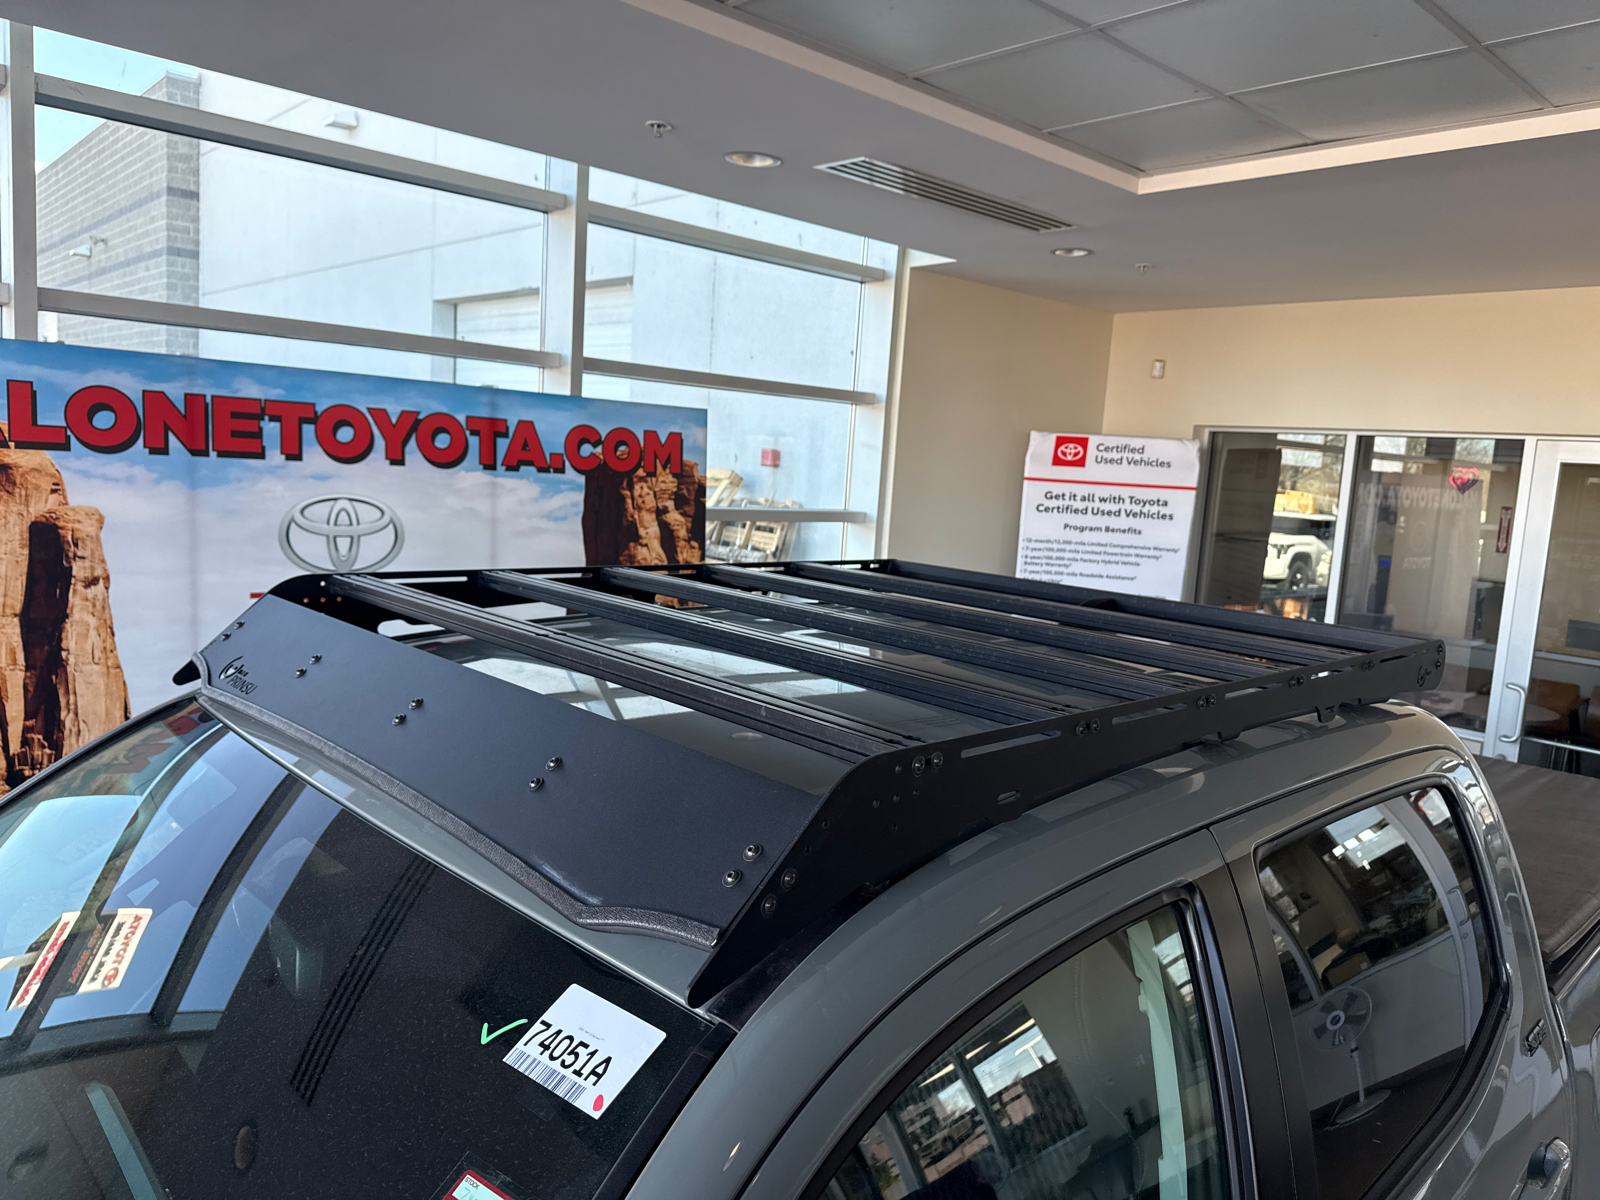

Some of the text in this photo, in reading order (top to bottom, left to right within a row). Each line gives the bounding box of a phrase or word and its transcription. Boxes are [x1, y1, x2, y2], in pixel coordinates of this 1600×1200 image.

[1096, 443, 1145, 455] Certified
[1095, 455, 1172, 468] Used Vehicles
[1044, 490, 1168, 509] Get it all with Toyota
[1036, 503, 1174, 521] Certified Used Vehicles
[1063, 523, 1142, 536] Program Benefits
[226, 675, 258, 695] PRINSU
[523, 1019, 613, 1087] 74051A
[464, 1176, 481, 1191] STOCK
